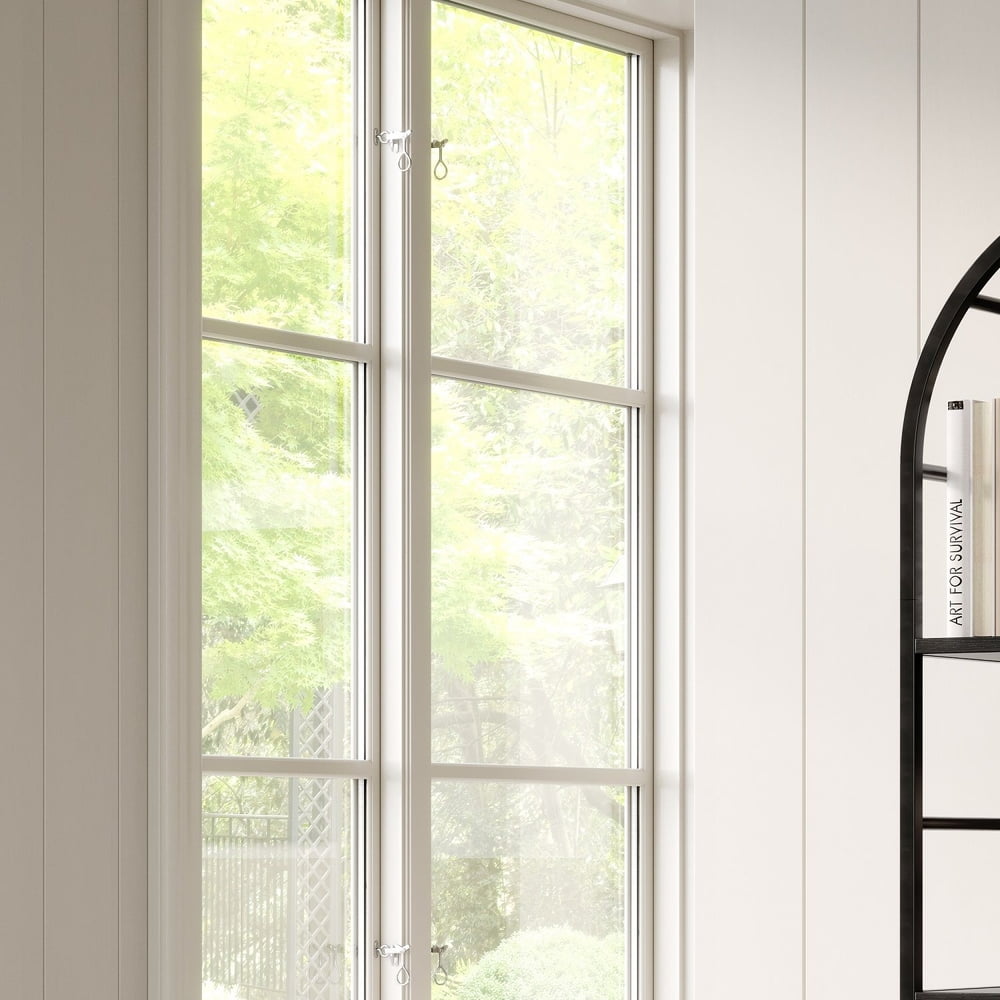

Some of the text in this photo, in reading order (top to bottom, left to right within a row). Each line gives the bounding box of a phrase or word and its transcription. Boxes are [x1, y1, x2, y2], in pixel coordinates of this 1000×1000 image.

[949, 498, 963, 627] ART FOR SURVIVAL
